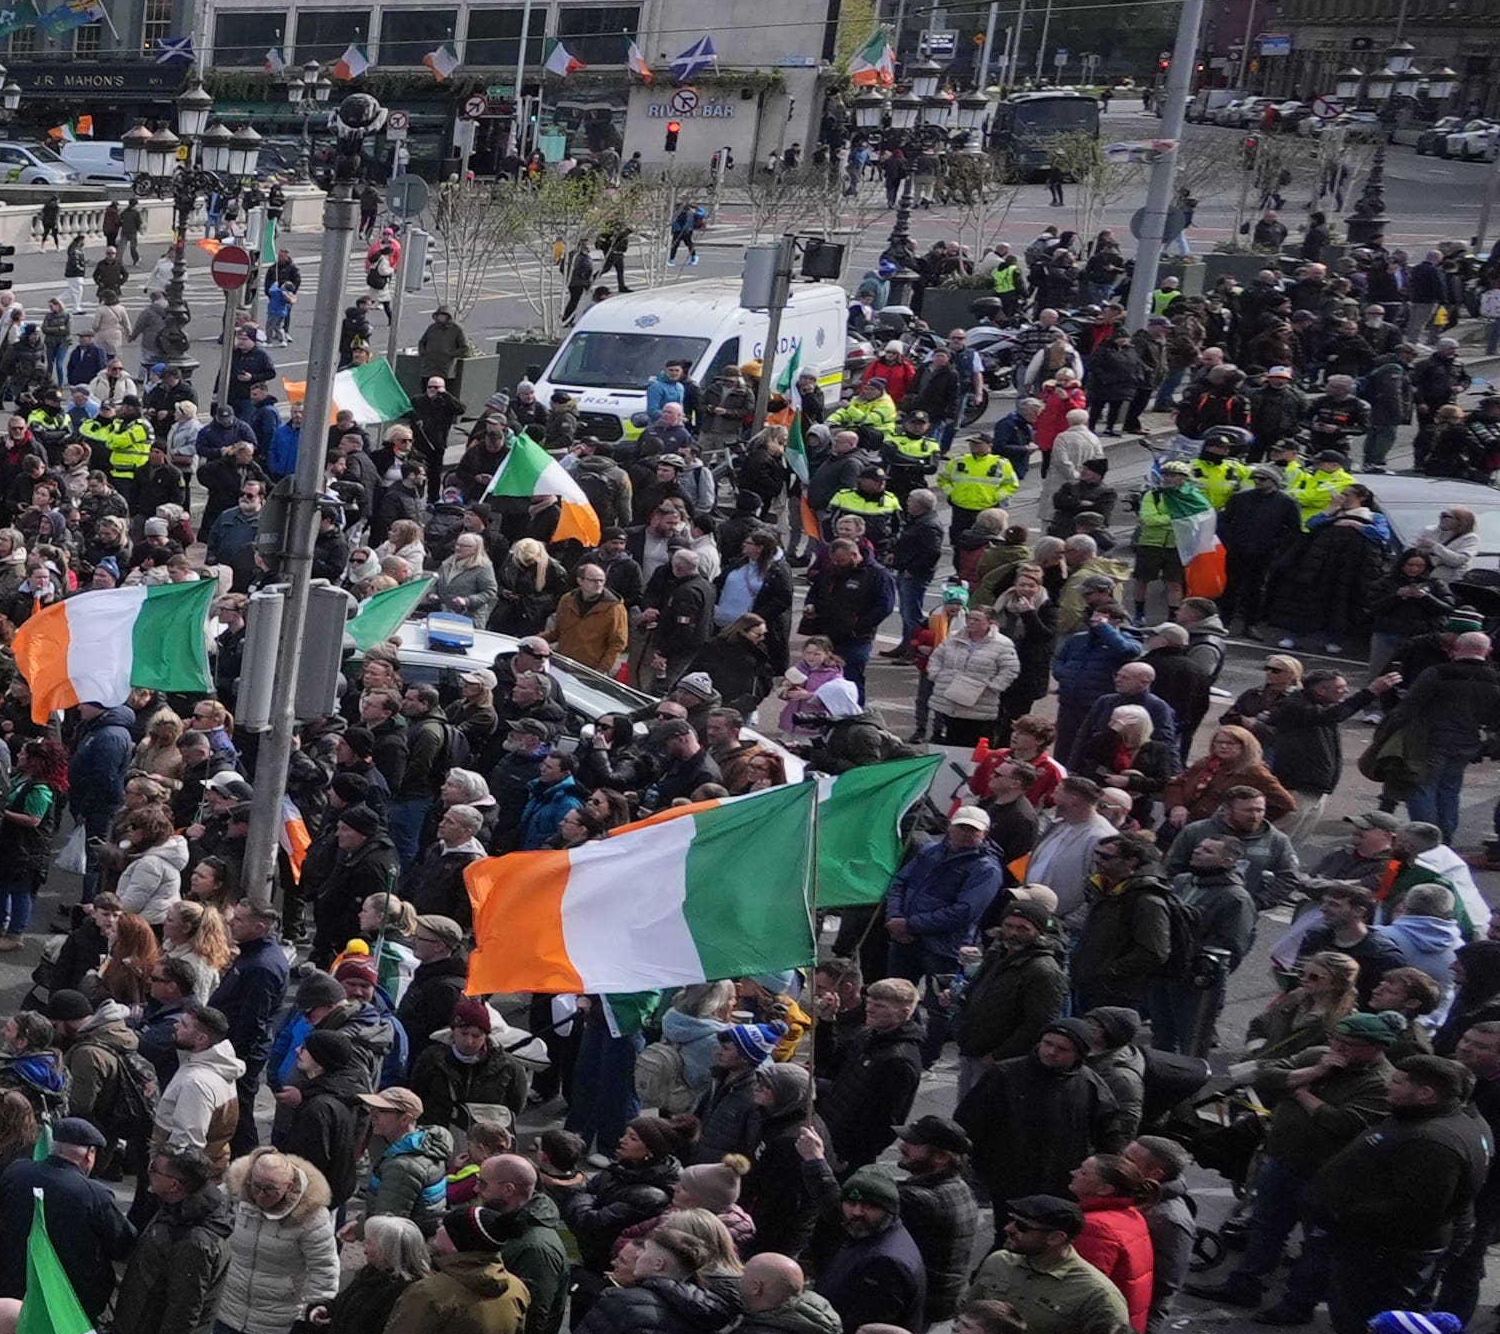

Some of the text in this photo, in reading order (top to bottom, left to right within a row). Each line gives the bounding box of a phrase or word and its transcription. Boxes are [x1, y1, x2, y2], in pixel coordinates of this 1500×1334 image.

[64, 76, 125, 86] MAHON'S
[649, 105, 734, 117] RIVR BAR
[753, 336, 798, 358] GDA
